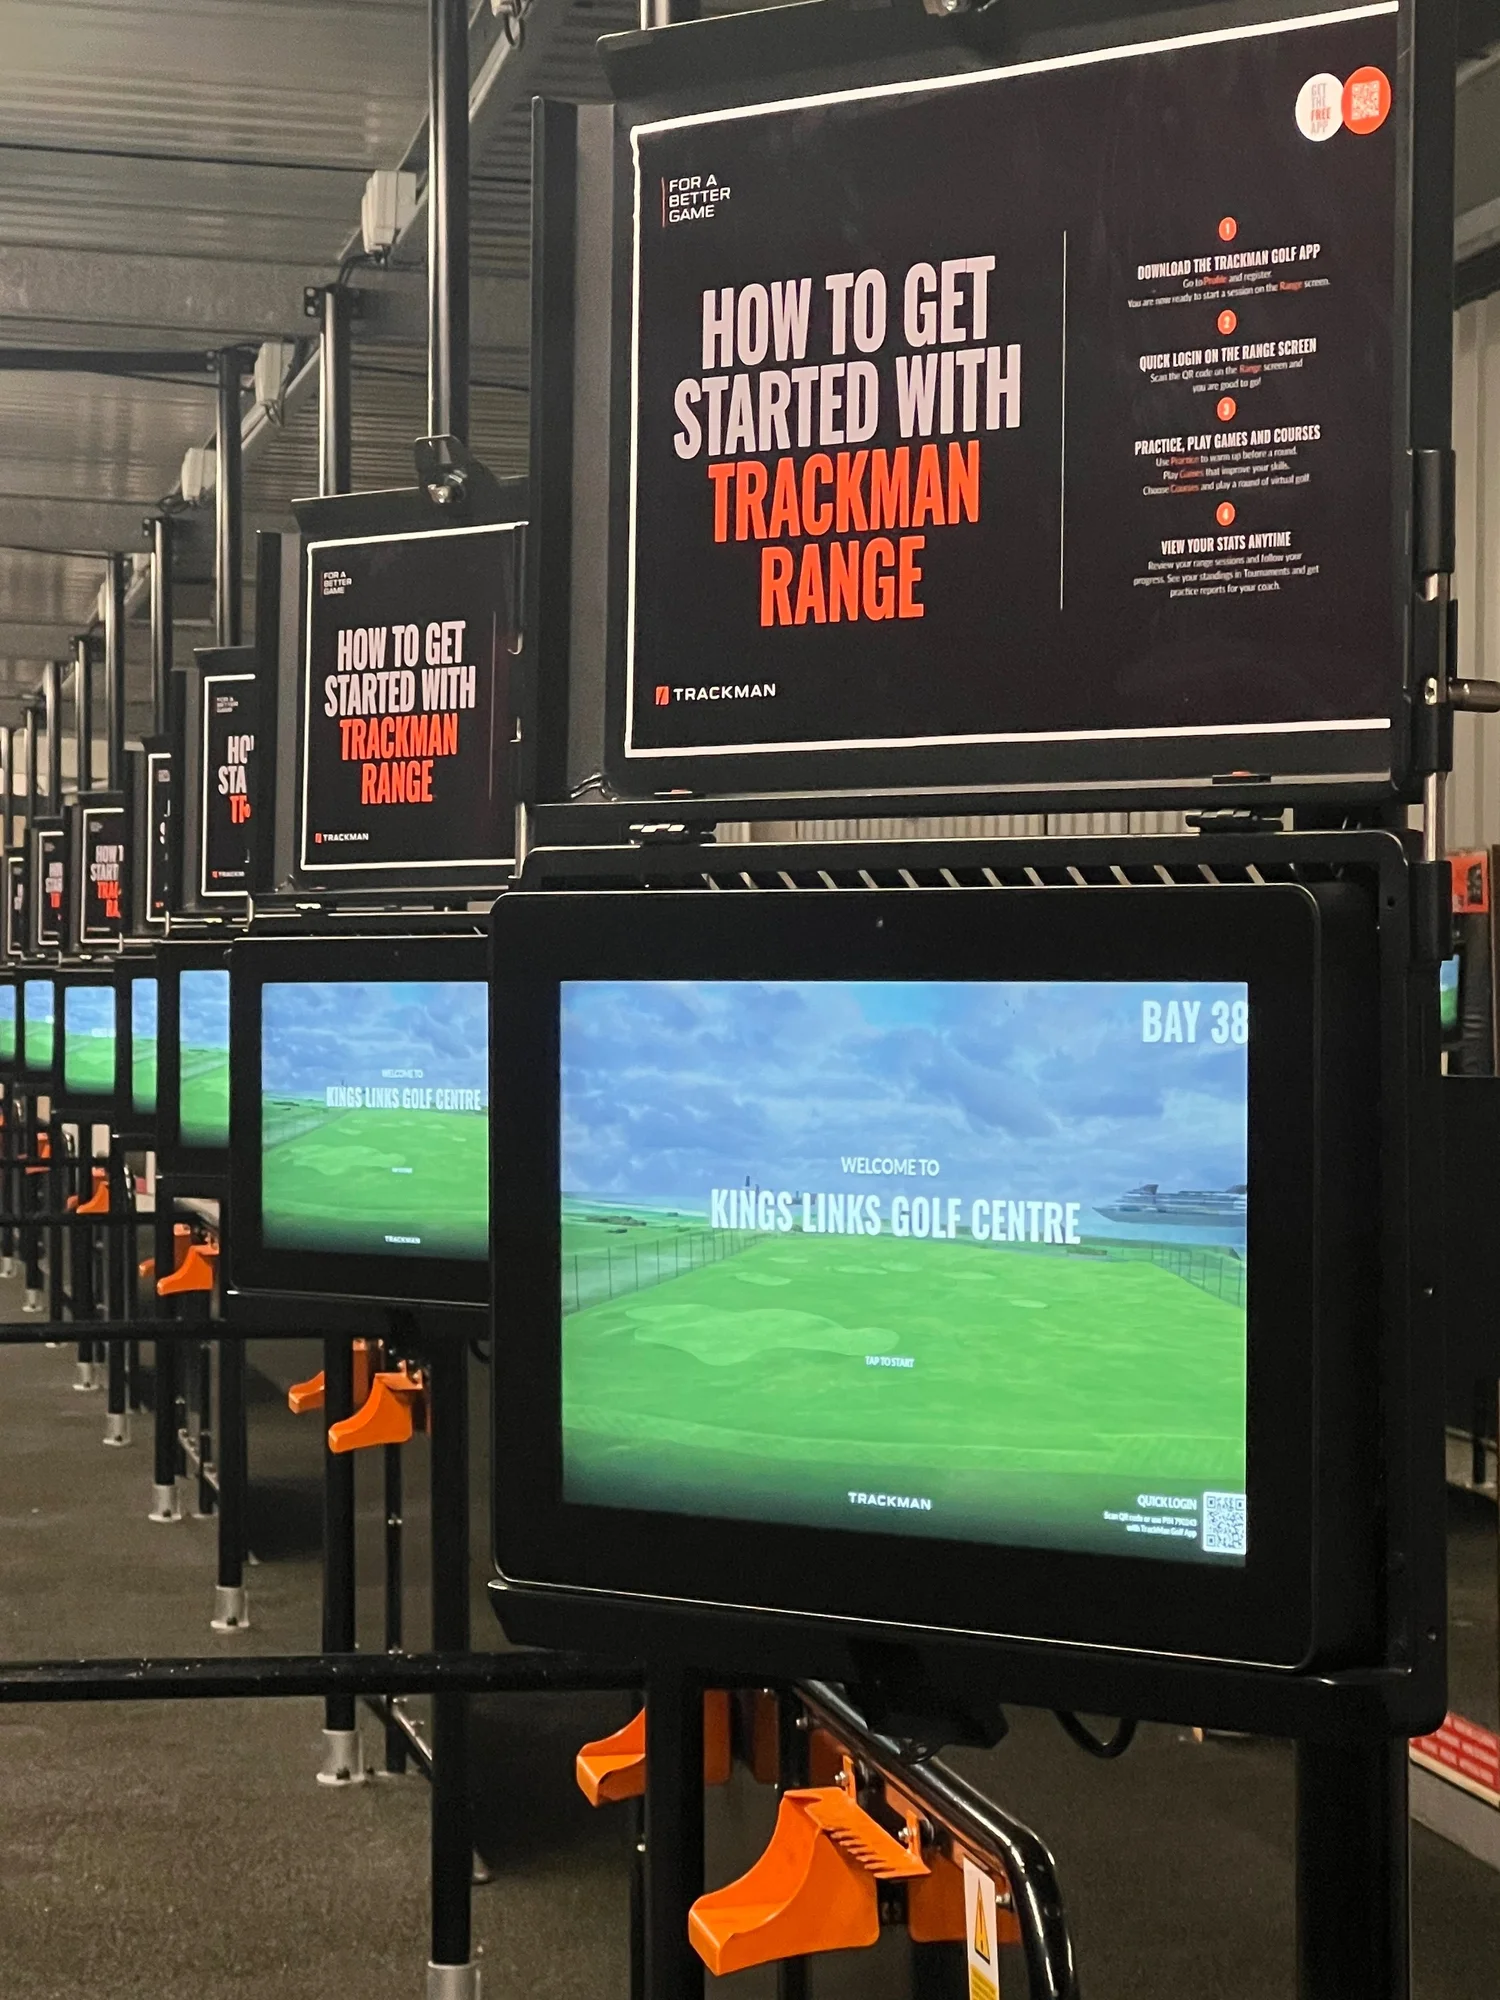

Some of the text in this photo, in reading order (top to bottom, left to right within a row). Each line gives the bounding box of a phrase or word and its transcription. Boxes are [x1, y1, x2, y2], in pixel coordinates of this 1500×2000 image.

[1310, 106, 1332, 122] FREE
[669, 174, 717, 192] FOR A
[669, 187, 731, 208] BETTER
[669, 204, 714, 222] GAME
[1138, 244, 1320, 280] DOWNLOAD THE TRACKMAN GOLF APP
[1183, 273, 1242, 288] Go to and
[1172, 293, 1192, 303] ready
[1203, 290, 1219, 299] start
[1227, 286, 1253, 297] session
[1266, 283, 1278, 292] the
[701, 255, 996, 370] HOW TO GET
[1140, 338, 1316, 372] QUICK LOGIN ON THE RANGE SCREEN
[1150, 373, 1167, 383] Scan
[1182, 370, 1194, 379] QR
[1195, 369, 1213, 378] code
[1226, 366, 1237, 374] the
[1263, 362, 1287, 371] screen
[1289, 358, 1303, 368] and
[1193, 385, 1206, 393] you
[1220, 378, 1239, 391] good
[673, 344, 1020, 460] STARTED WITH
[1135, 424, 1321, 455] PRACTICE, PLAY GAMES AND COURSES
[1156, 458, 1170, 467] Use
[1232, 452, 1241, 461] up
[1243, 450, 1266, 460] before
[1163, 471, 1178, 480] Play
[1206, 468, 1220, 476] that
[1222, 466, 1250, 476] improve
[1252, 464, 1269, 474] your
[708, 440, 980, 544] TRACKMAN
[1143, 486, 1169, 496] Choose
[1201, 482, 1214, 490] and
[1216, 481, 1230, 491] play
[1238, 479, 1260, 487] round
[1261, 477, 1269, 486] of
[1271, 475, 1294, 484] virtual
[1161, 532, 1291, 555] VIEW YOUR STATS ANYTIME
[1148, 553, 1303, 570] Review your range sessions and follow your
[324, 578, 352, 587] BETTER
[760, 535, 925, 627] RANGE
[1167, 574, 1180, 583] See
[1182, 574, 1198, 584] your
[1199, 570, 1233, 581] standings
[1235, 570, 1242, 578] in
[1244, 567, 1290, 578] Tournaments
[1292, 565, 1306, 575] and
[1306, 565, 1319, 575] get
[324, 587, 344, 595] GAME
[1170, 588, 1198, 598] practice
[1200, 586, 1225, 595] reports
[1227, 584, 1238, 593] for
[1240, 584, 1256, 594] your
[337, 620, 466, 672] HOW TO GET
[324, 666, 476, 717] STARTED WITH
[673, 683, 776, 701] TRACKMAN
[339, 713, 458, 760] TRACKMAN
[227, 734, 254, 764] HO
[361, 760, 434, 804] RANGE
[323, 833, 369, 841] TRACKMAN
[1142, 1000, 1248, 1044] BAY 38
[382, 1069, 424, 1078] WELCOME TO
[326, 1086, 481, 1111] KINGS LINKS GOLF CENTRE
[841, 1156, 940, 1177] WELCOME TO
[711, 1188, 1082, 1245] KINGS LINKS GOLF CENTRE
[865, 1356, 914, 1368] TAP TO START
[848, 1491, 932, 1510] TRACKMAN
[1137, 1494, 1197, 1510] QUICK LOGIN
